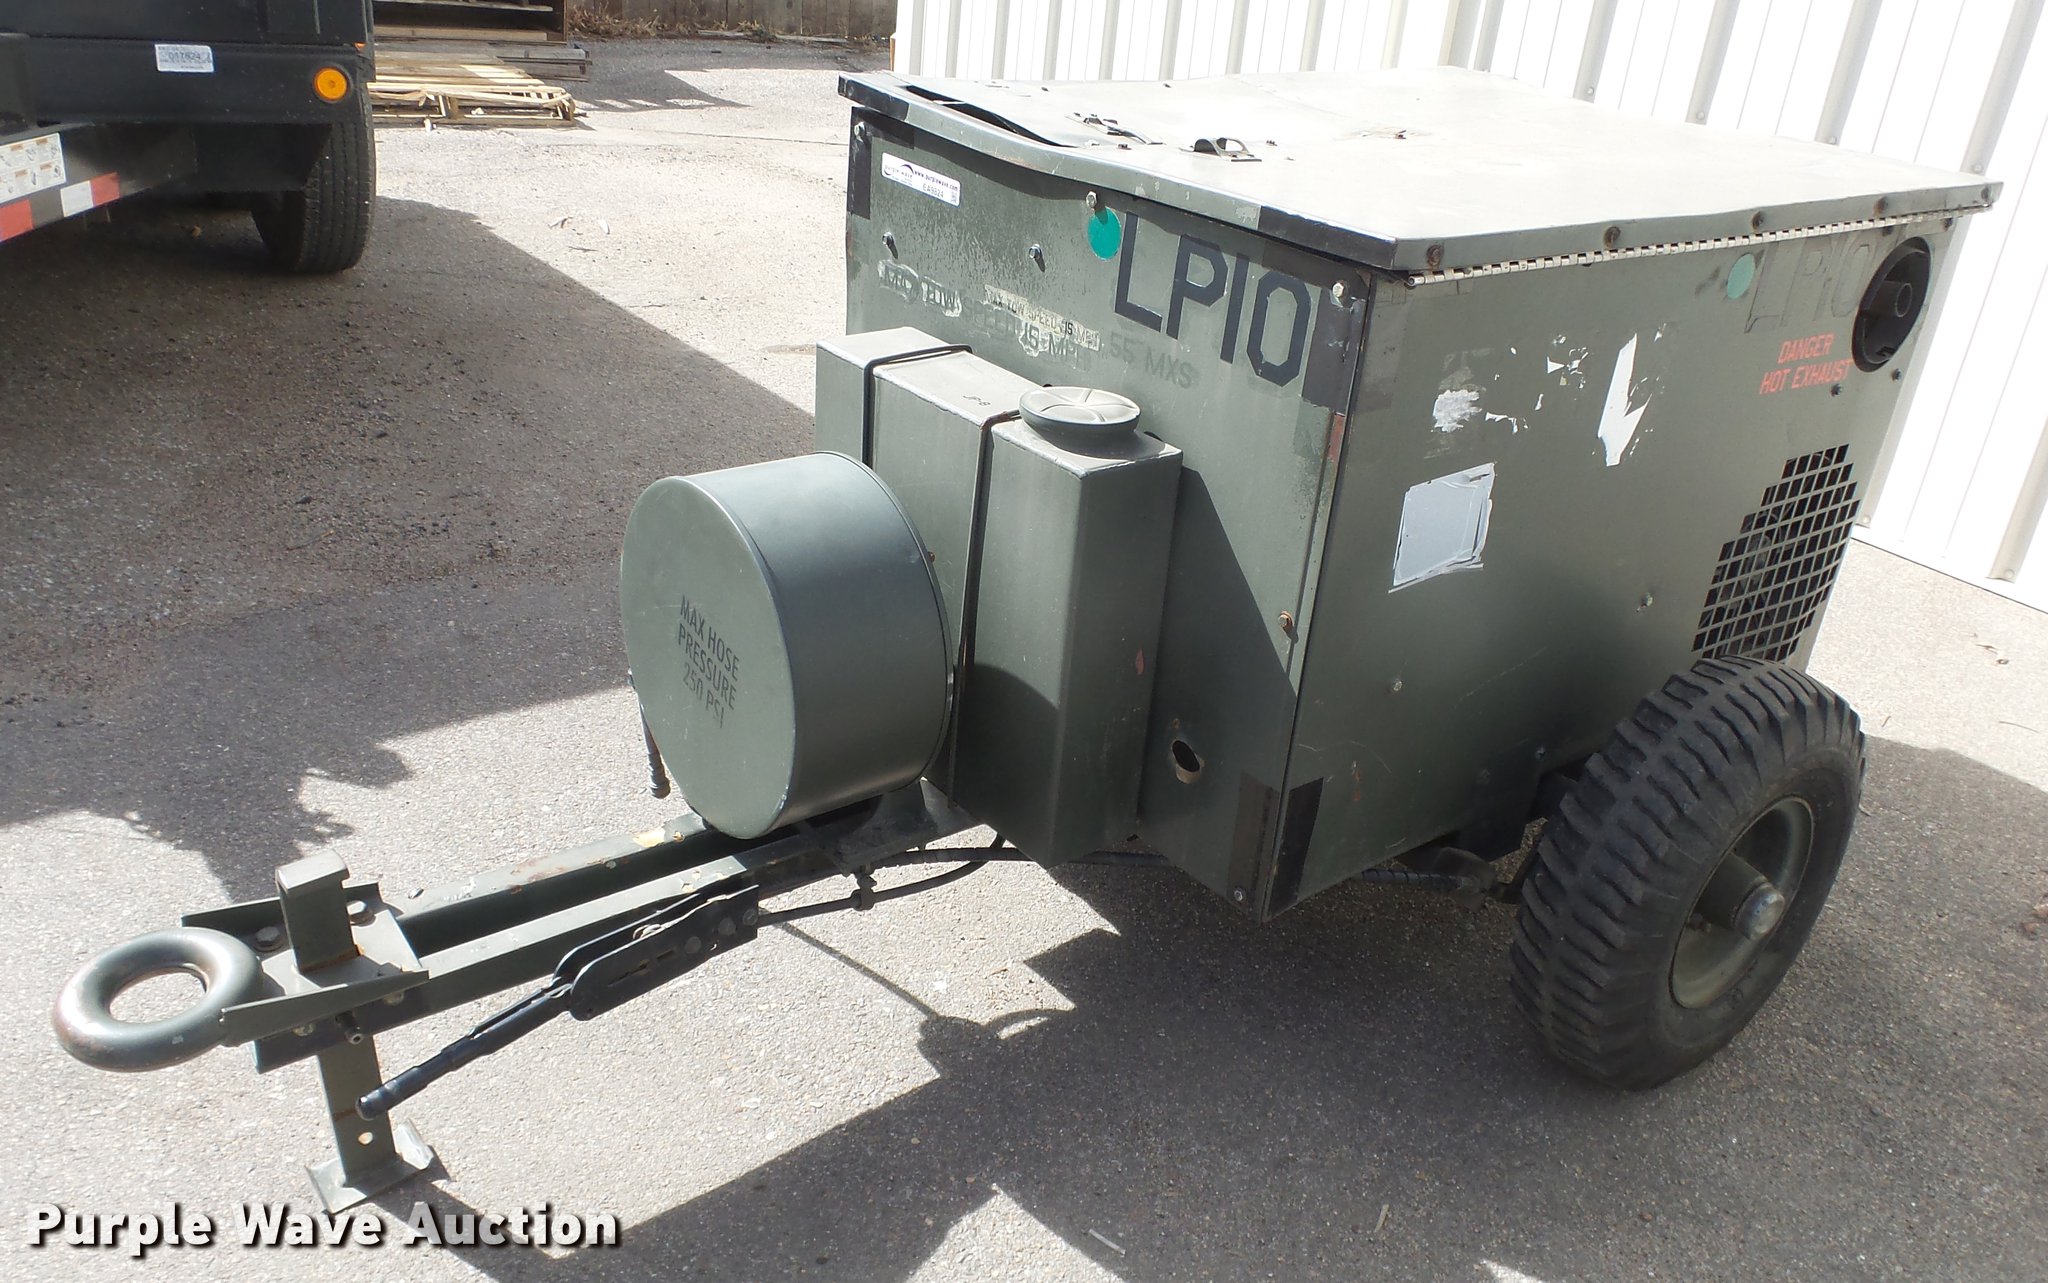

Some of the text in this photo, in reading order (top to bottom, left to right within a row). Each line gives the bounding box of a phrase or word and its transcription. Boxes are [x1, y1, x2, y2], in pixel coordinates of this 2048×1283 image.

[1777, 333, 1835, 364] DANGER
[1759, 358, 1855, 395] HOT EXHAUST
[680, 595, 740, 681] MAX HOSE
[678, 623, 737, 710] PRESSURE
[706, 690, 725, 728] PSI
